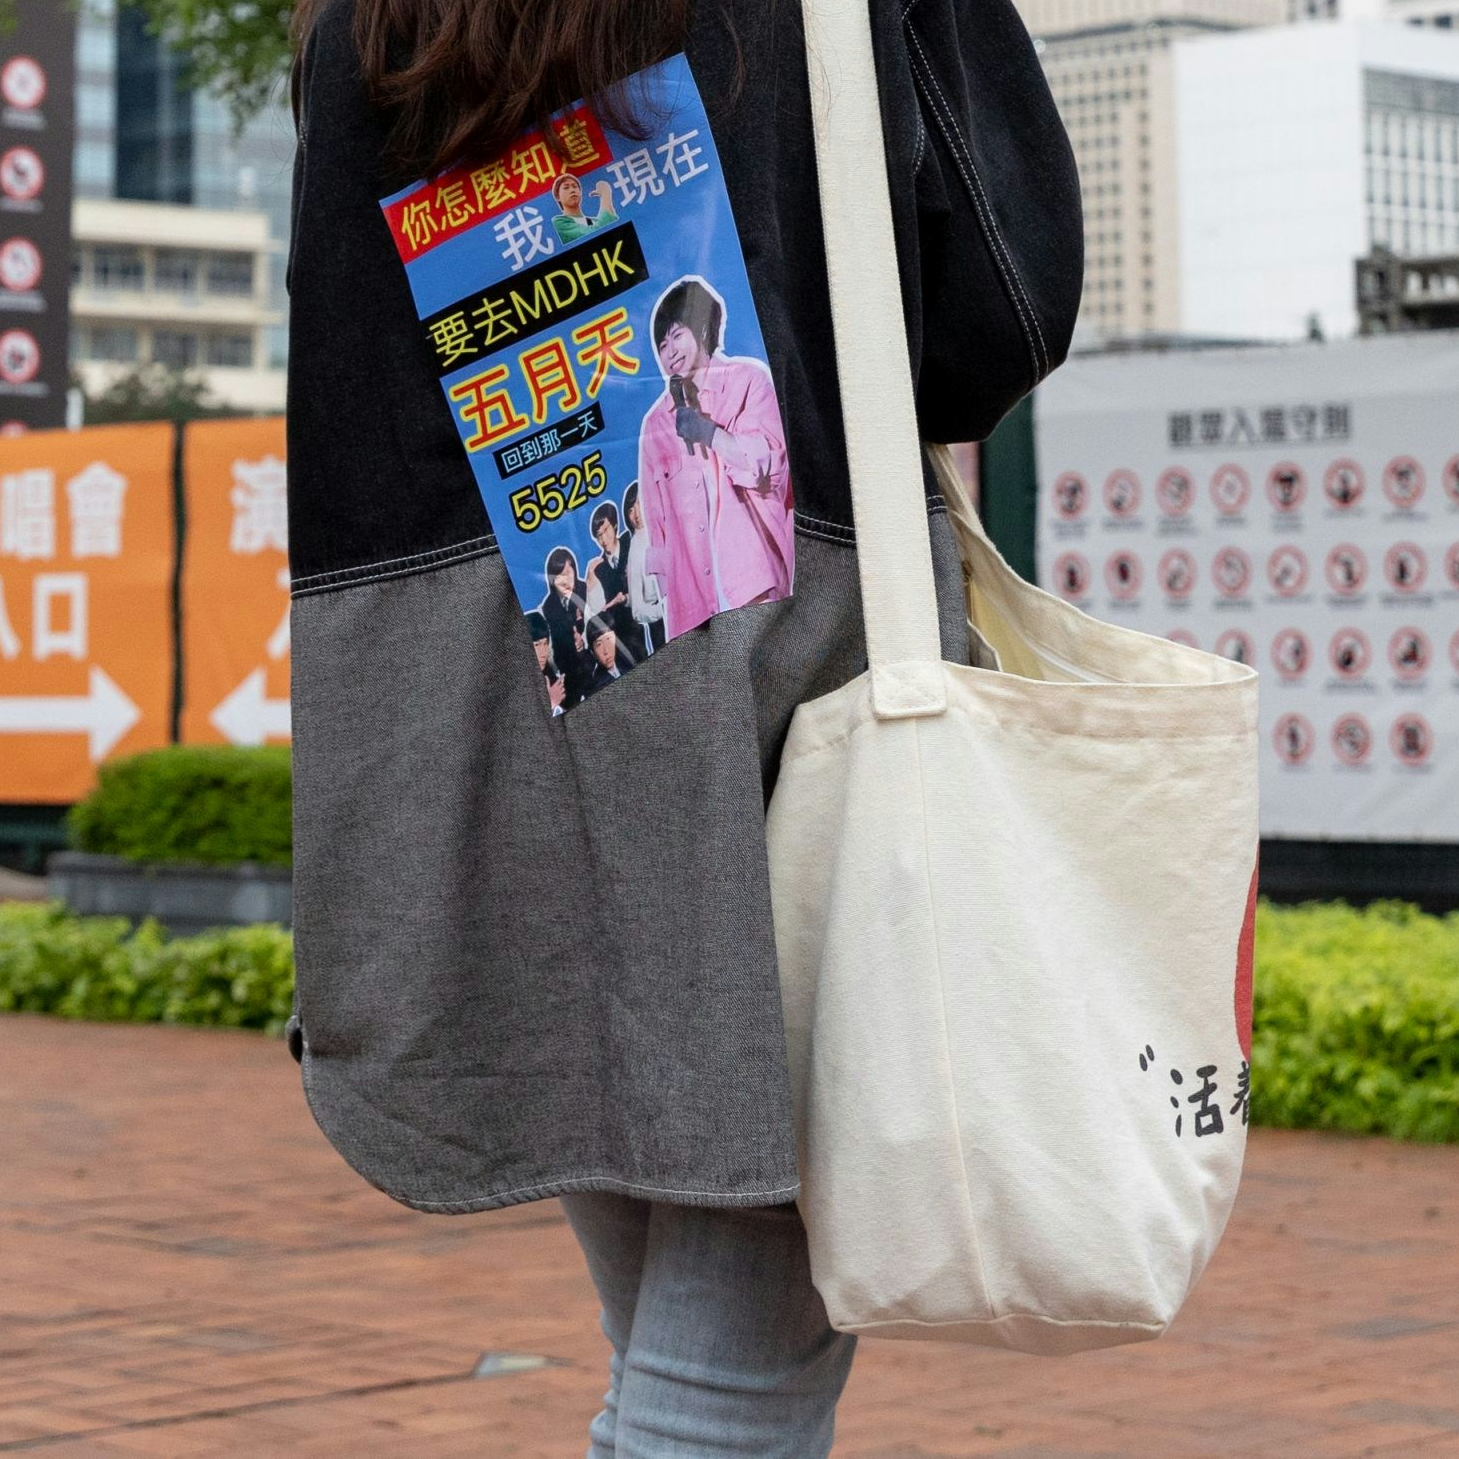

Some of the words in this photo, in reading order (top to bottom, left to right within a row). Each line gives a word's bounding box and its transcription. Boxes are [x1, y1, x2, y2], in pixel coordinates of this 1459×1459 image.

[400, 121, 601, 252] 你怎麼知道
[494, 205, 555, 272] 我
[607, 128, 709, 209] 現在
[427, 240, 635, 368] 要去MDHK
[449, 306, 641, 454] 五月天
[501, 410, 599, 475] 回到那一天
[511, 453, 608, 533] 5525
